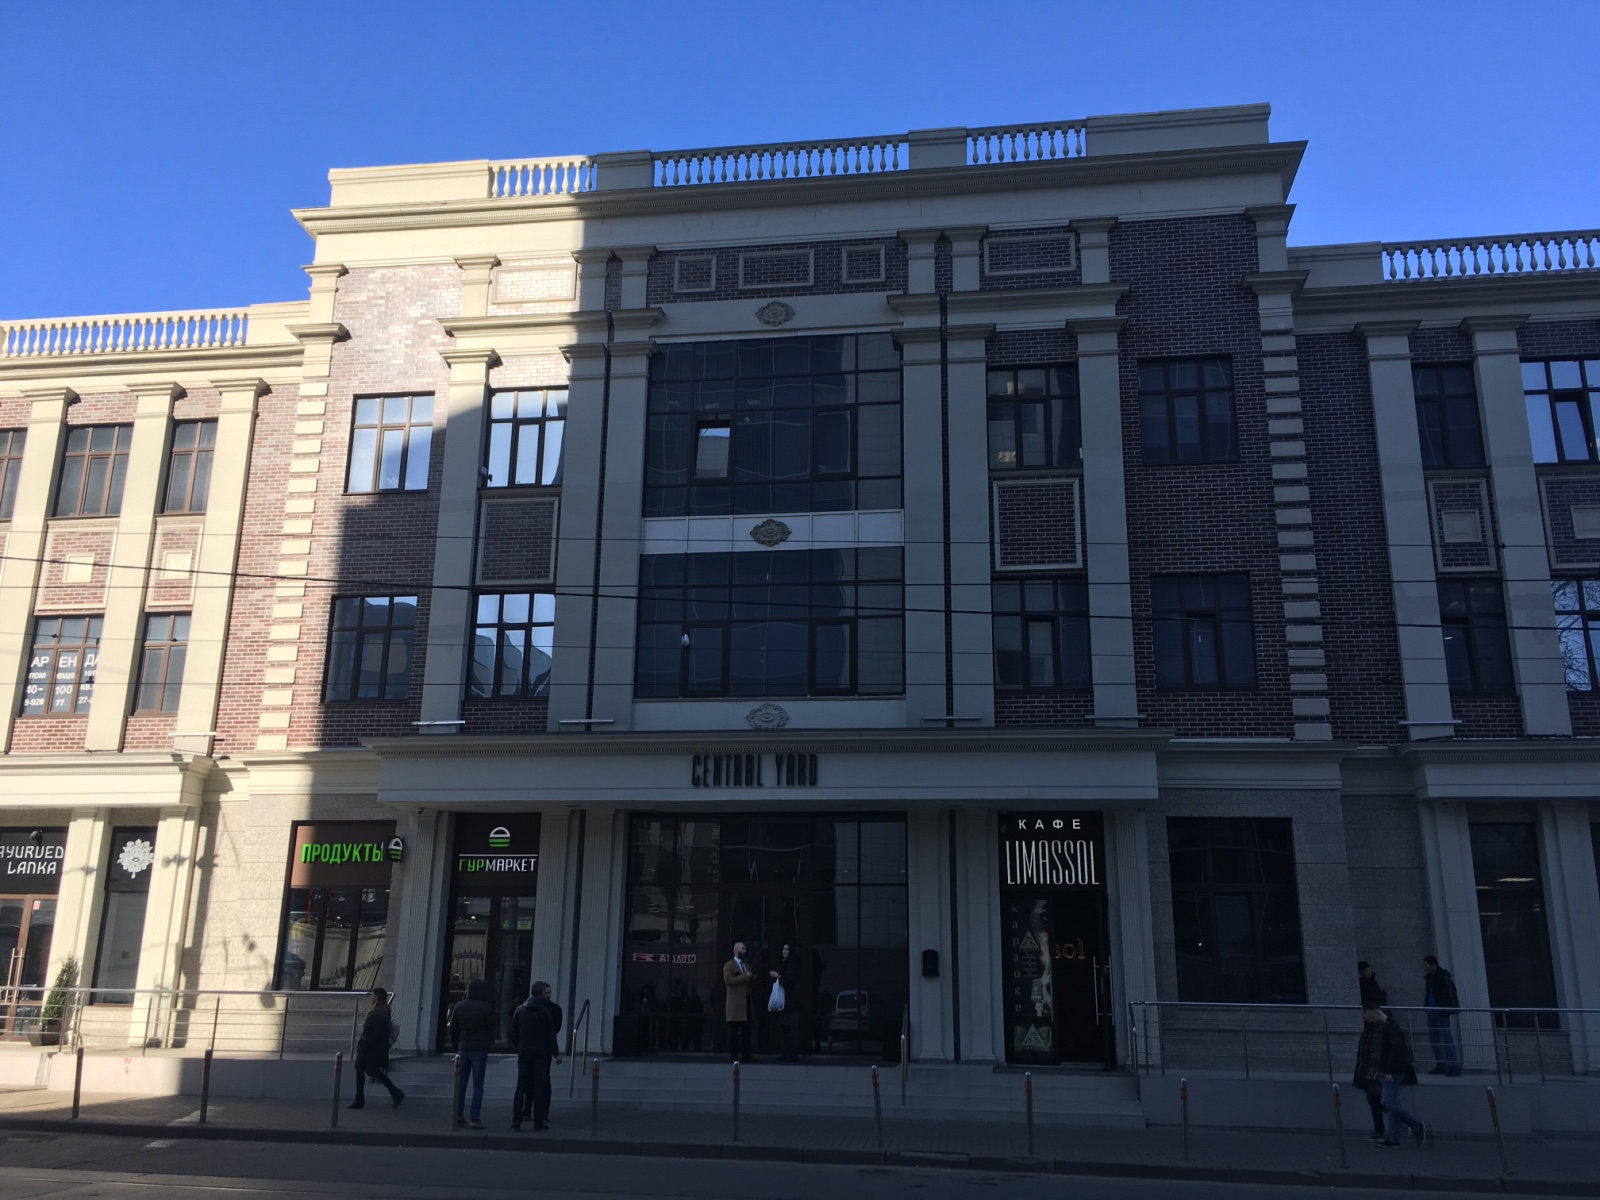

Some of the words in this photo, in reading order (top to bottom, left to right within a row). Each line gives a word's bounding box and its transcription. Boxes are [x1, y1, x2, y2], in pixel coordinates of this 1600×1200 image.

[55, 685, 73, 695] 100
[692, 753, 763, 787] CENTRAL
[775, 753, 818, 787] YARD
[1018, 818, 1081, 830] КАФЕ
[0, 845, 64, 859] AYURVED
[301, 843, 384, 864] ПРОДУКТЫ
[7, 861, 57, 874] LANKA
[458, 858, 537, 872] ГУРМАРКЕТ
[1005, 839, 1100, 885] LIMASSOL
